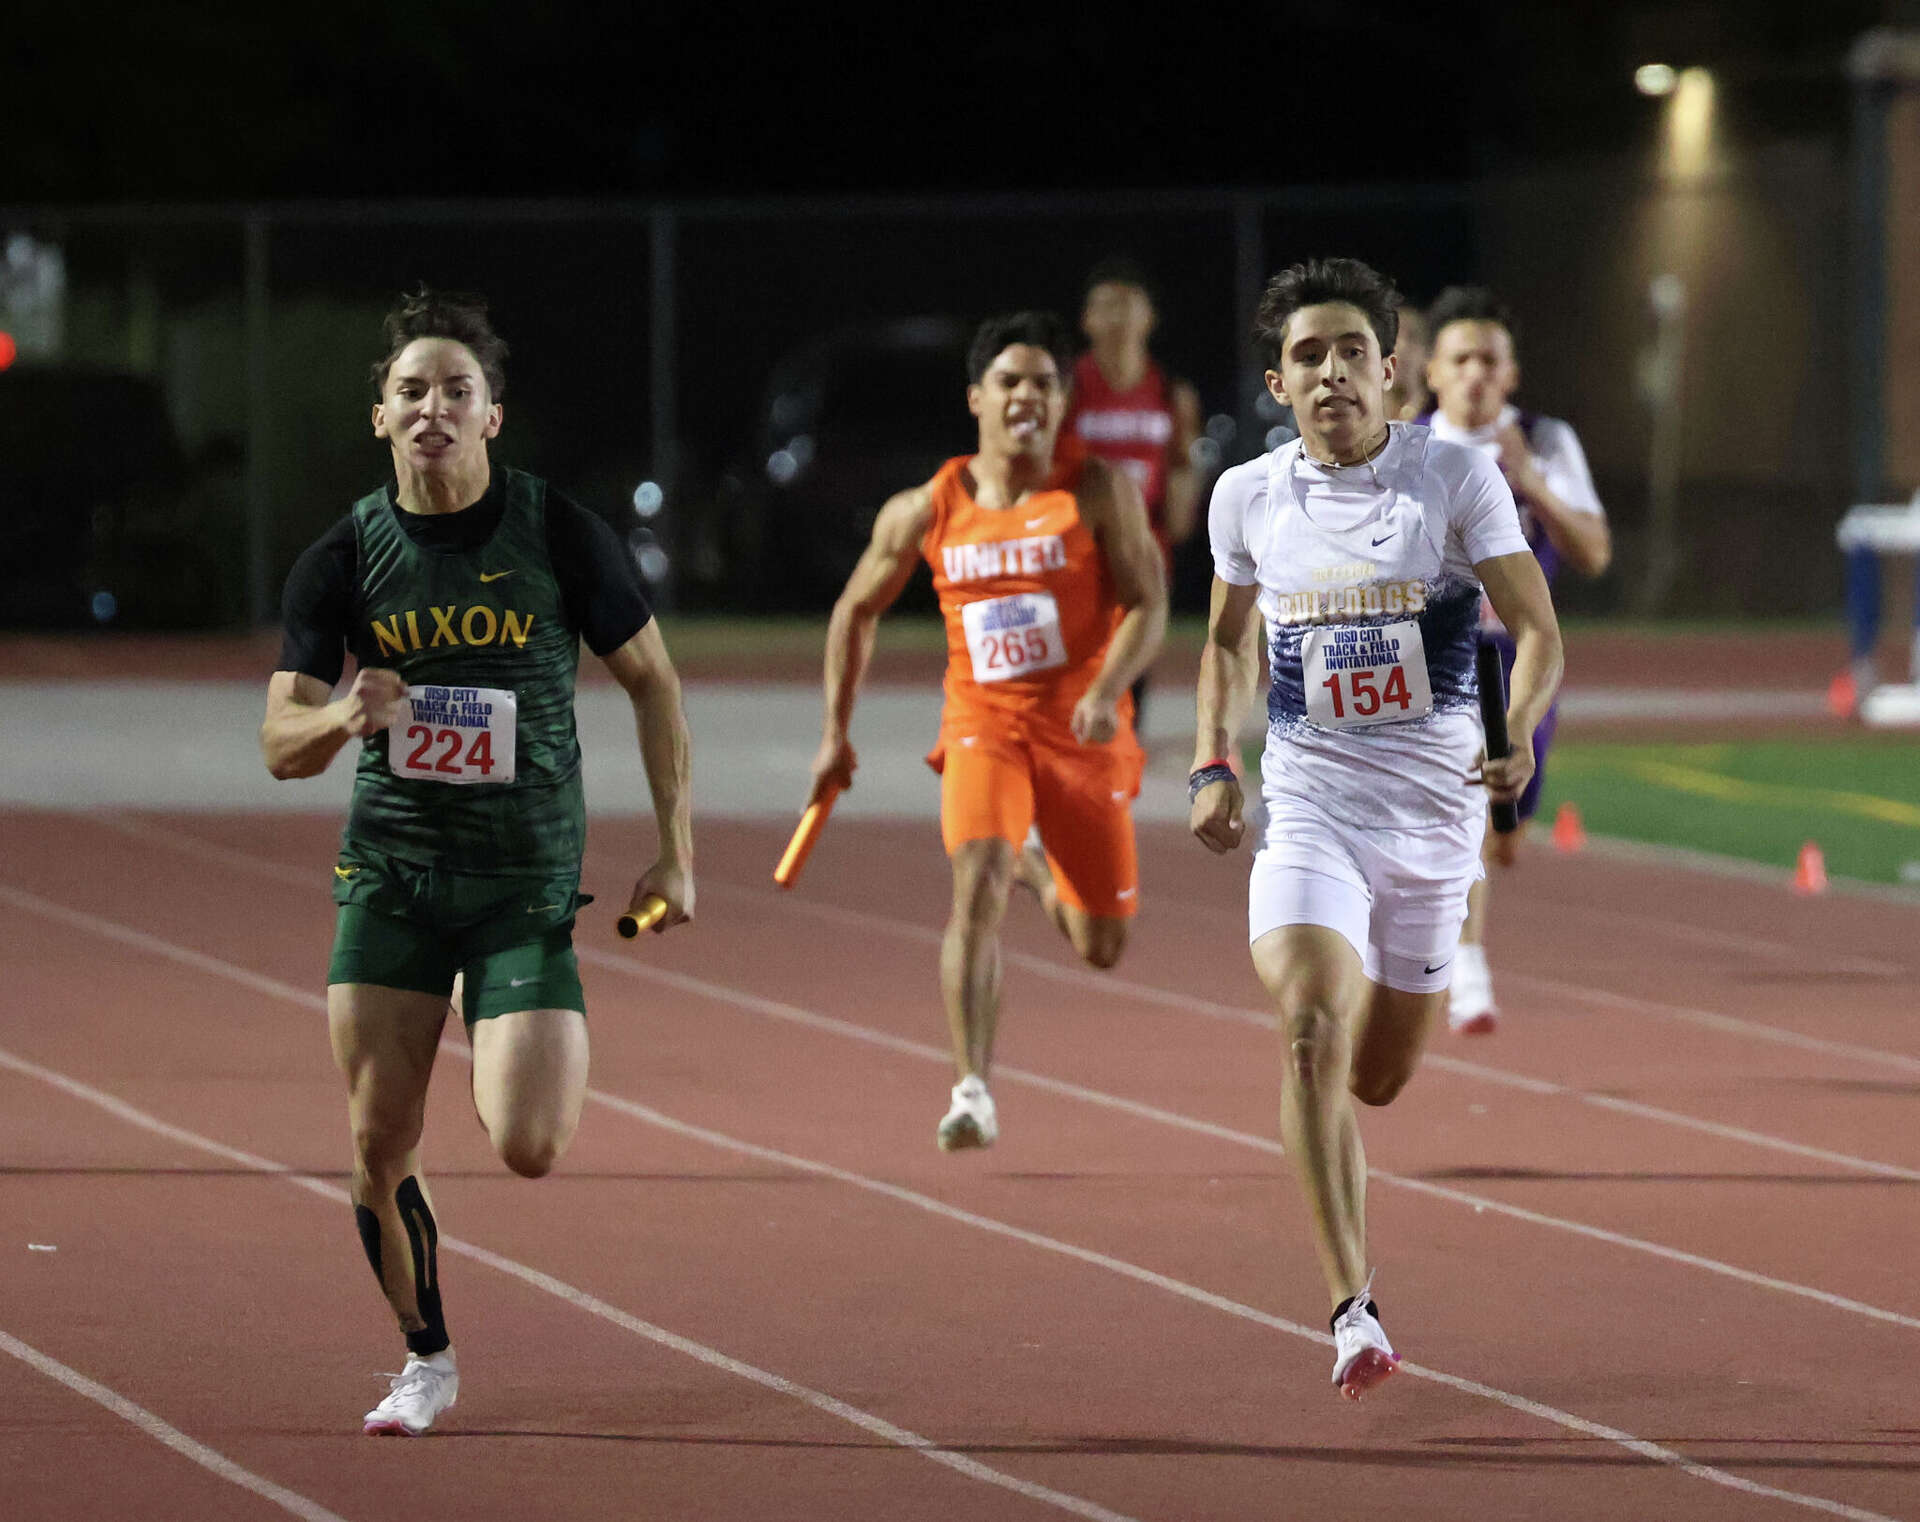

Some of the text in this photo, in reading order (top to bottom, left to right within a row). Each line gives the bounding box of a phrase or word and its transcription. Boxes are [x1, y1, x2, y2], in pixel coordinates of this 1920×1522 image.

[942, 535, 1066, 582] UNITED
[1278, 580, 1425, 624] BULLDOGS
[371, 605, 535, 657] NIXON
[1334, 628, 1383, 643] UISD CITY
[981, 628, 1048, 669] 265
[1323, 639, 1400, 657] TRACK & FIELD
[1325, 652, 1400, 670] INVITATIONAL
[424, 687, 478, 702] UISD CITY
[1323, 666, 1412, 718] 154
[410, 699, 447, 714] TRACK
[462, 703, 492, 715] FIELD
[413, 711, 489, 728] INVITATIONAL
[406, 725, 495, 775] 224
